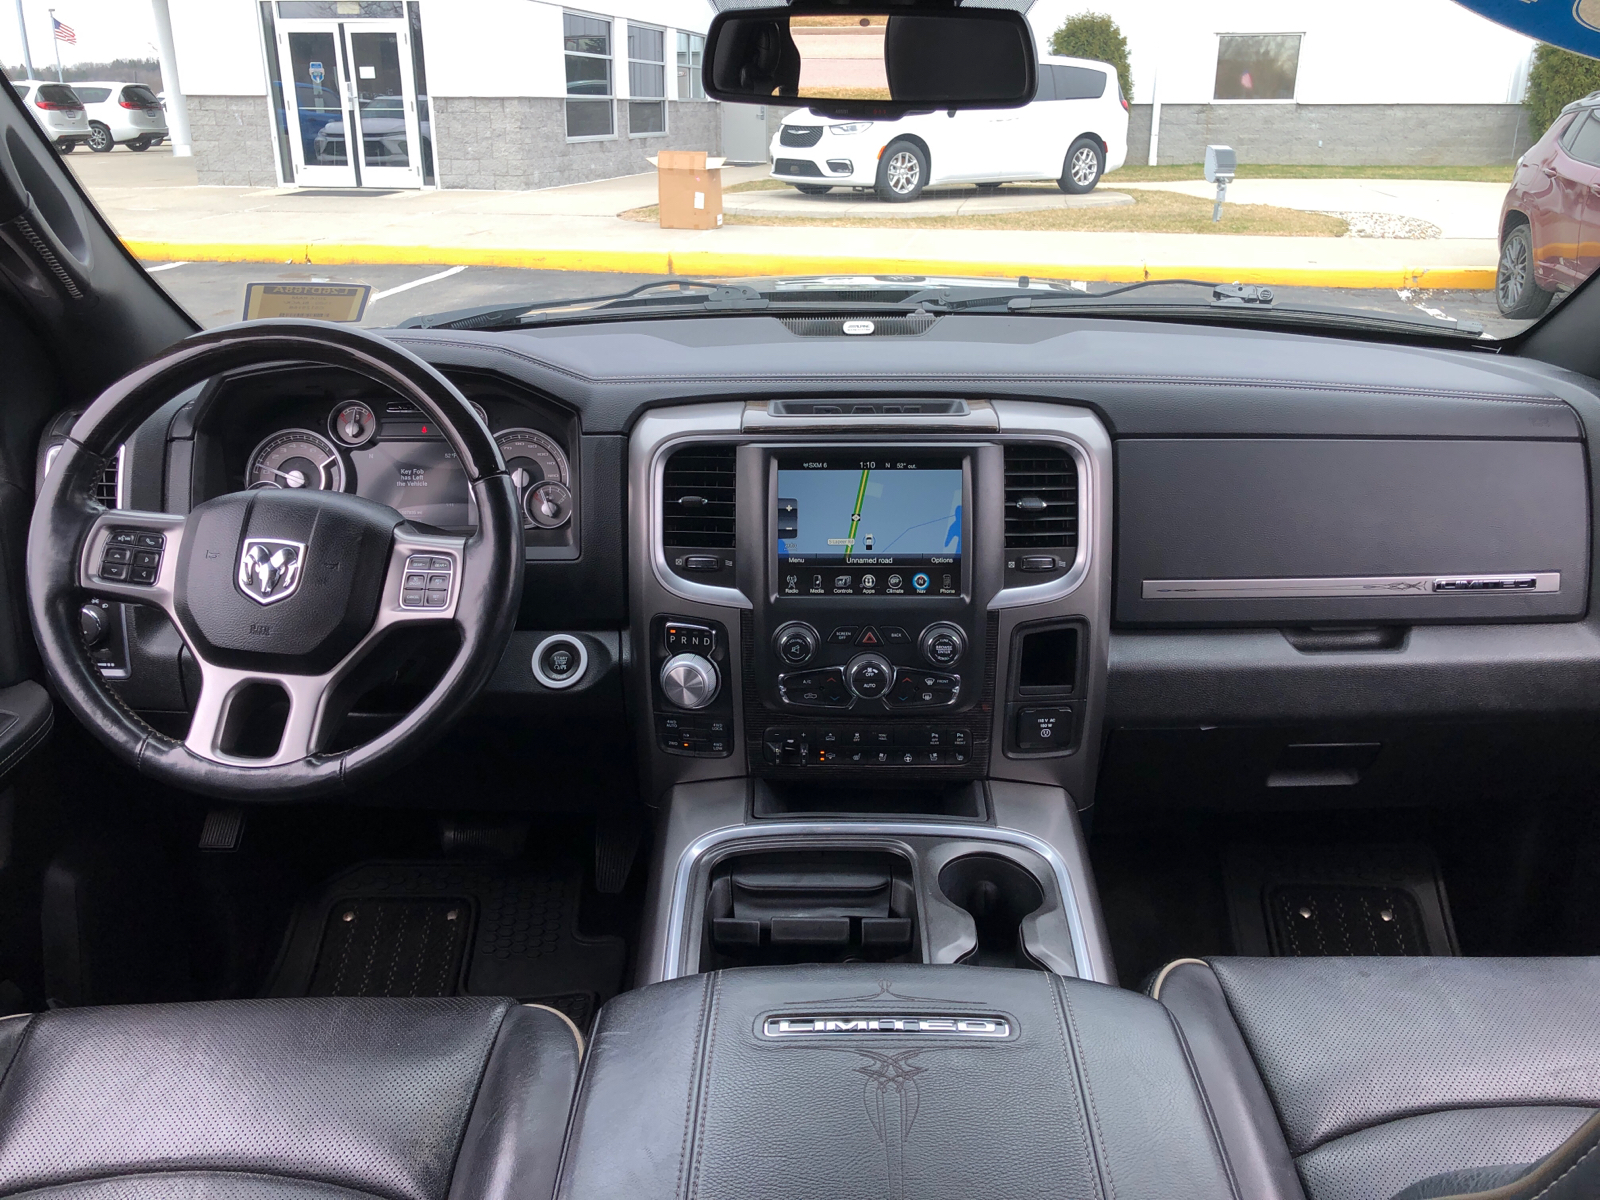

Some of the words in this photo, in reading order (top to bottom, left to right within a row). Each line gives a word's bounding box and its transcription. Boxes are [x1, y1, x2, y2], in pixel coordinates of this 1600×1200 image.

[859, 461, 876, 469] 1:10
[931, 557, 953, 565] Options
[681, 636, 688, 644] R
[692, 637, 699, 645] N
[703, 637, 710, 645] D
[778, 1020, 997, 1032] LIMITED
